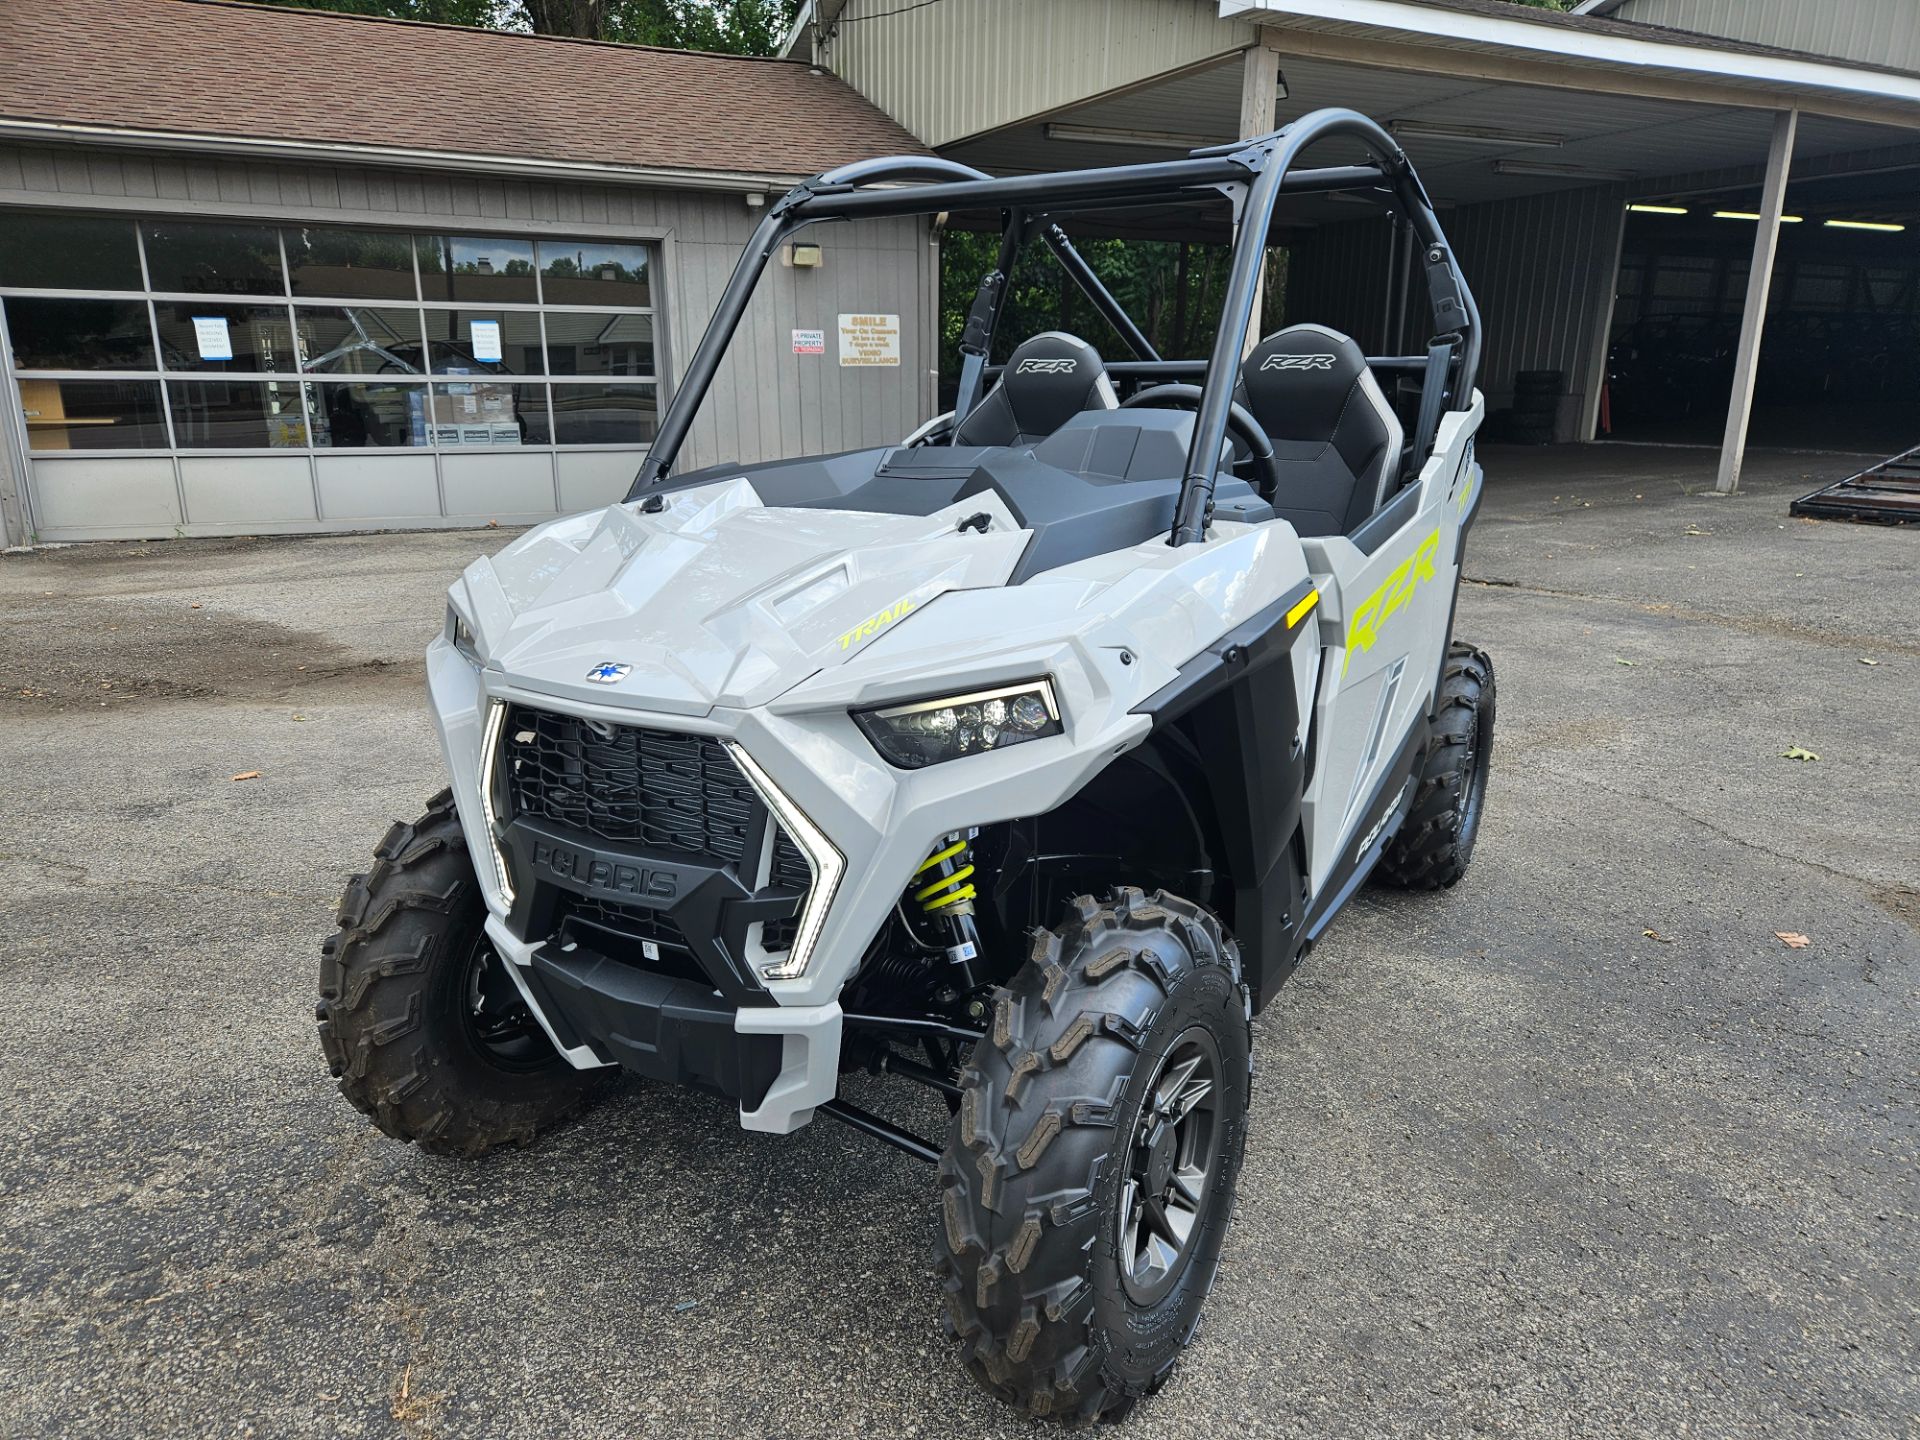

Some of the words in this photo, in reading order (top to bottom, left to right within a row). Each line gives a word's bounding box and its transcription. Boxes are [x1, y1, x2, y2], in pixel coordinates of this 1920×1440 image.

[851, 316, 887, 327] SMILE
[800, 332, 822, 340] PRIVATE
[1016, 359, 1077, 374] RZR
[1260, 354, 1337, 371] RZR
[1341, 527, 1440, 681] RZR
[837, 598, 916, 651] TRAIL
[531, 841, 678, 899] POLARIS
